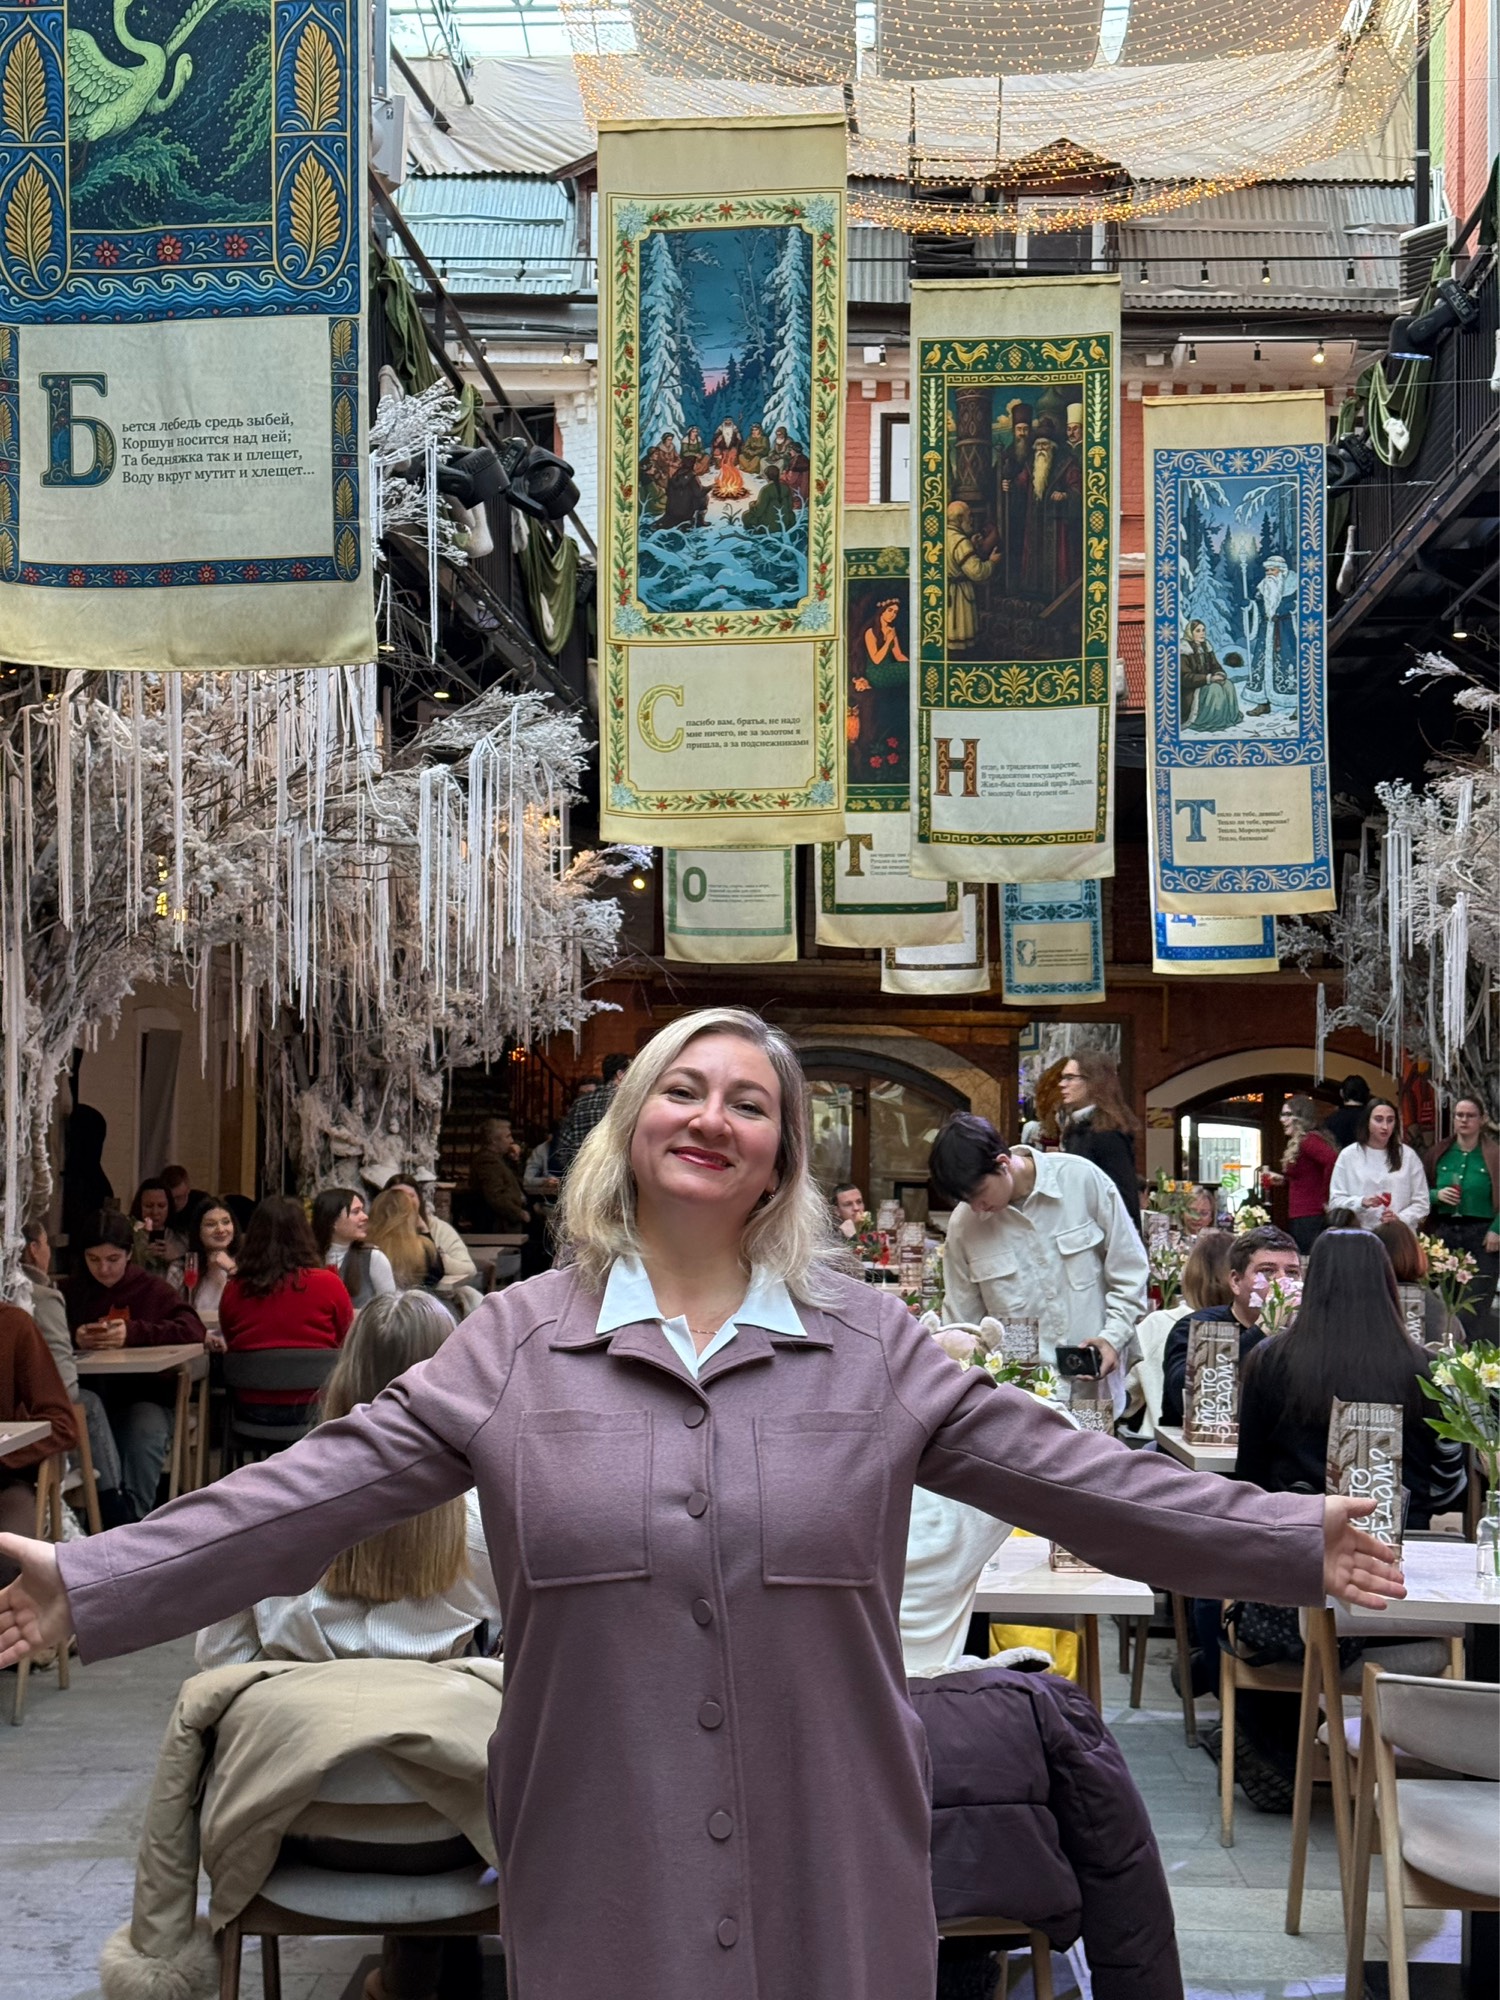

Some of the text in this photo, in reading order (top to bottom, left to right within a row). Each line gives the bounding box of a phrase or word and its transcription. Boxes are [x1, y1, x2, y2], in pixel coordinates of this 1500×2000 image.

[38, 371, 117, 488] Б
[160, 417, 201, 432] лебедь
[205, 416, 243, 431] средь
[247, 413, 294, 427] зыбей,
[122, 431, 292, 452] Коршун носится над ней;
[122, 449, 302, 467] Та бедняжка так и плещет,
[122, 466, 315, 485] Воду вкруг мутит и хлещет...
[637, 684, 684, 753] С
[737, 718, 767, 727] братья,
[781, 717, 800, 725] надо
[686, 741, 721, 750] пришла,
[740, 740, 809, 748] подснежниками
[933, 737, 981, 797] Н
[1175, 799, 1216, 842] Т
